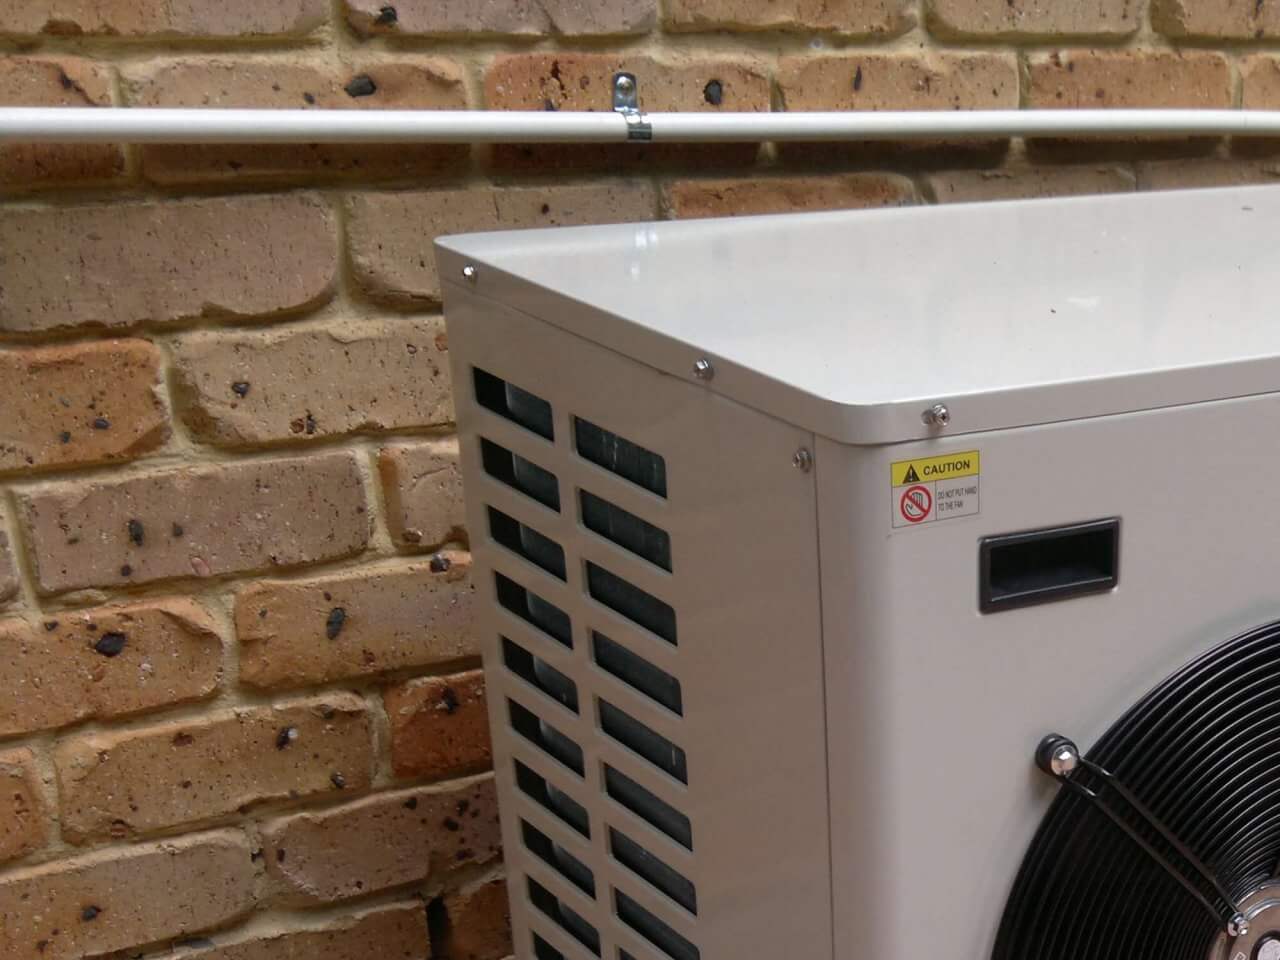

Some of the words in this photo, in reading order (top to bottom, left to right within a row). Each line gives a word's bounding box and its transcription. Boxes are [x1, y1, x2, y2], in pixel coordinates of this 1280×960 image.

[923, 460, 970, 476] CAUTION
[945, 488, 954, 498] NOT
[955, 487, 963, 497] PUT
[938, 502, 944, 511] TO
[945, 501, 953, 510] THE
[954, 500, 963, 509] FAN
